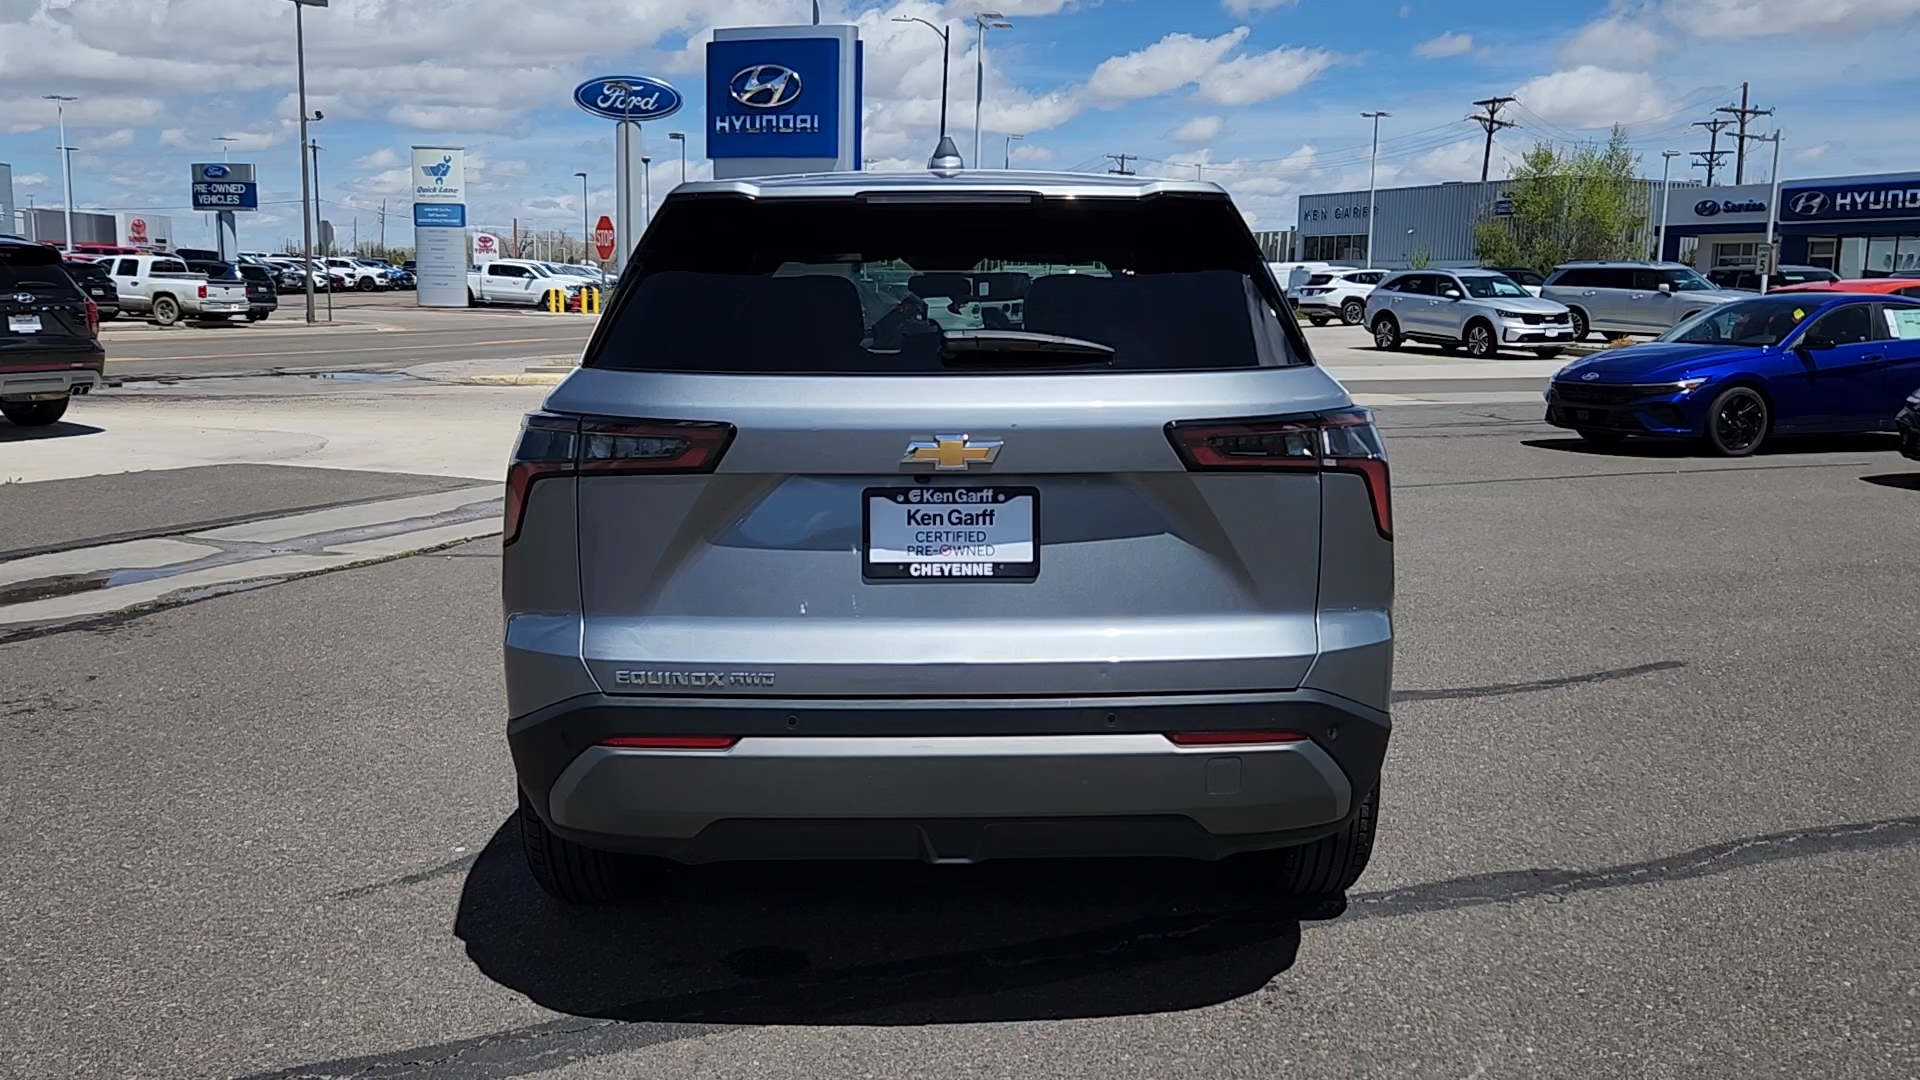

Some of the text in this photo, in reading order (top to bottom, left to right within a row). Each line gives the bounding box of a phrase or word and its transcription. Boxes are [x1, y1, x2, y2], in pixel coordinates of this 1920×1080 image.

[597, 82, 658, 111] Ford
[716, 114, 819, 134] HYUNDAI
[194, 183, 246, 194] PRE-OWNED
[198, 194, 240, 204] VEHICLES
[1304, 208, 1327, 221] KEN
[596, 229, 613, 247] STOP
[1759, 260, 1766, 272] 5
[923, 488, 994, 502] Ken Garff
[907, 508, 995, 526] Ken Garff
[915, 531, 987, 543] CERTIFIED
[909, 563, 994, 577] CHEYENNE
[615, 670, 775, 686] EQUINOX AWD
